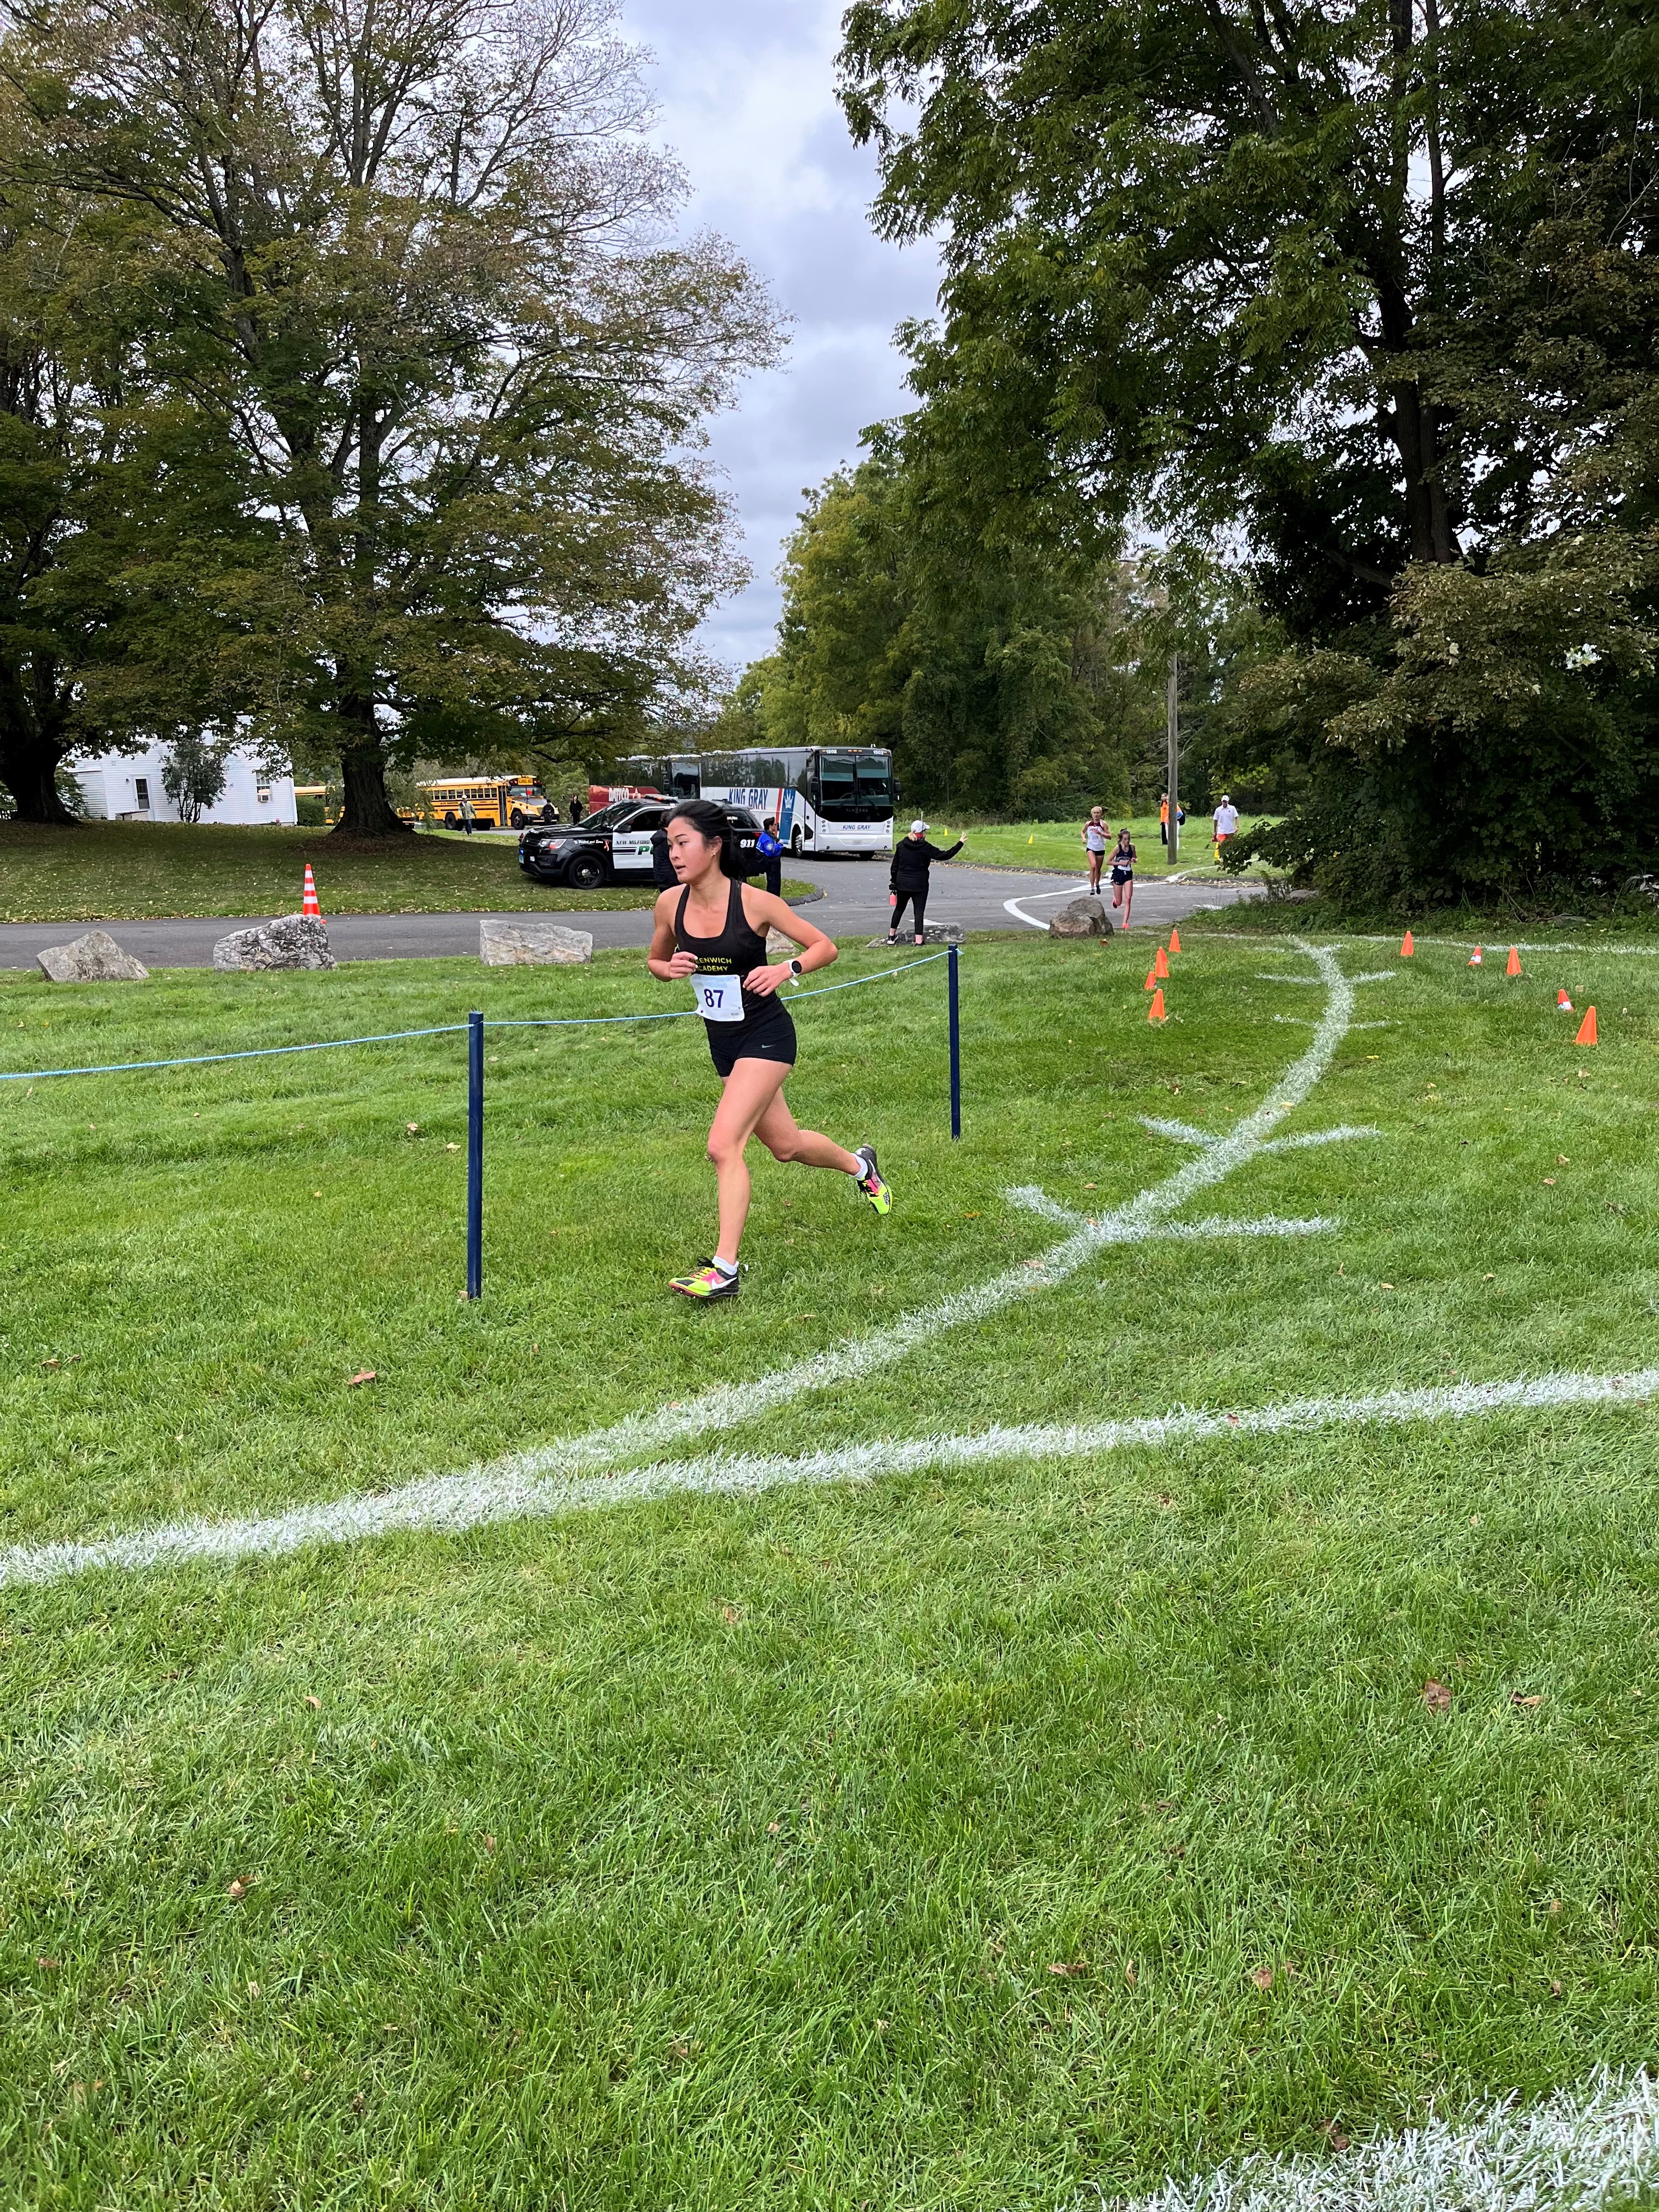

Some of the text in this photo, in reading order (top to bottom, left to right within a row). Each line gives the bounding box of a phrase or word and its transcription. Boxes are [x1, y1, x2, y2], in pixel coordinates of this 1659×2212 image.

[729, 788, 768, 810] KING GRAY
[740, 839, 755, 848] 911
[704, 989, 724, 1008] 87
